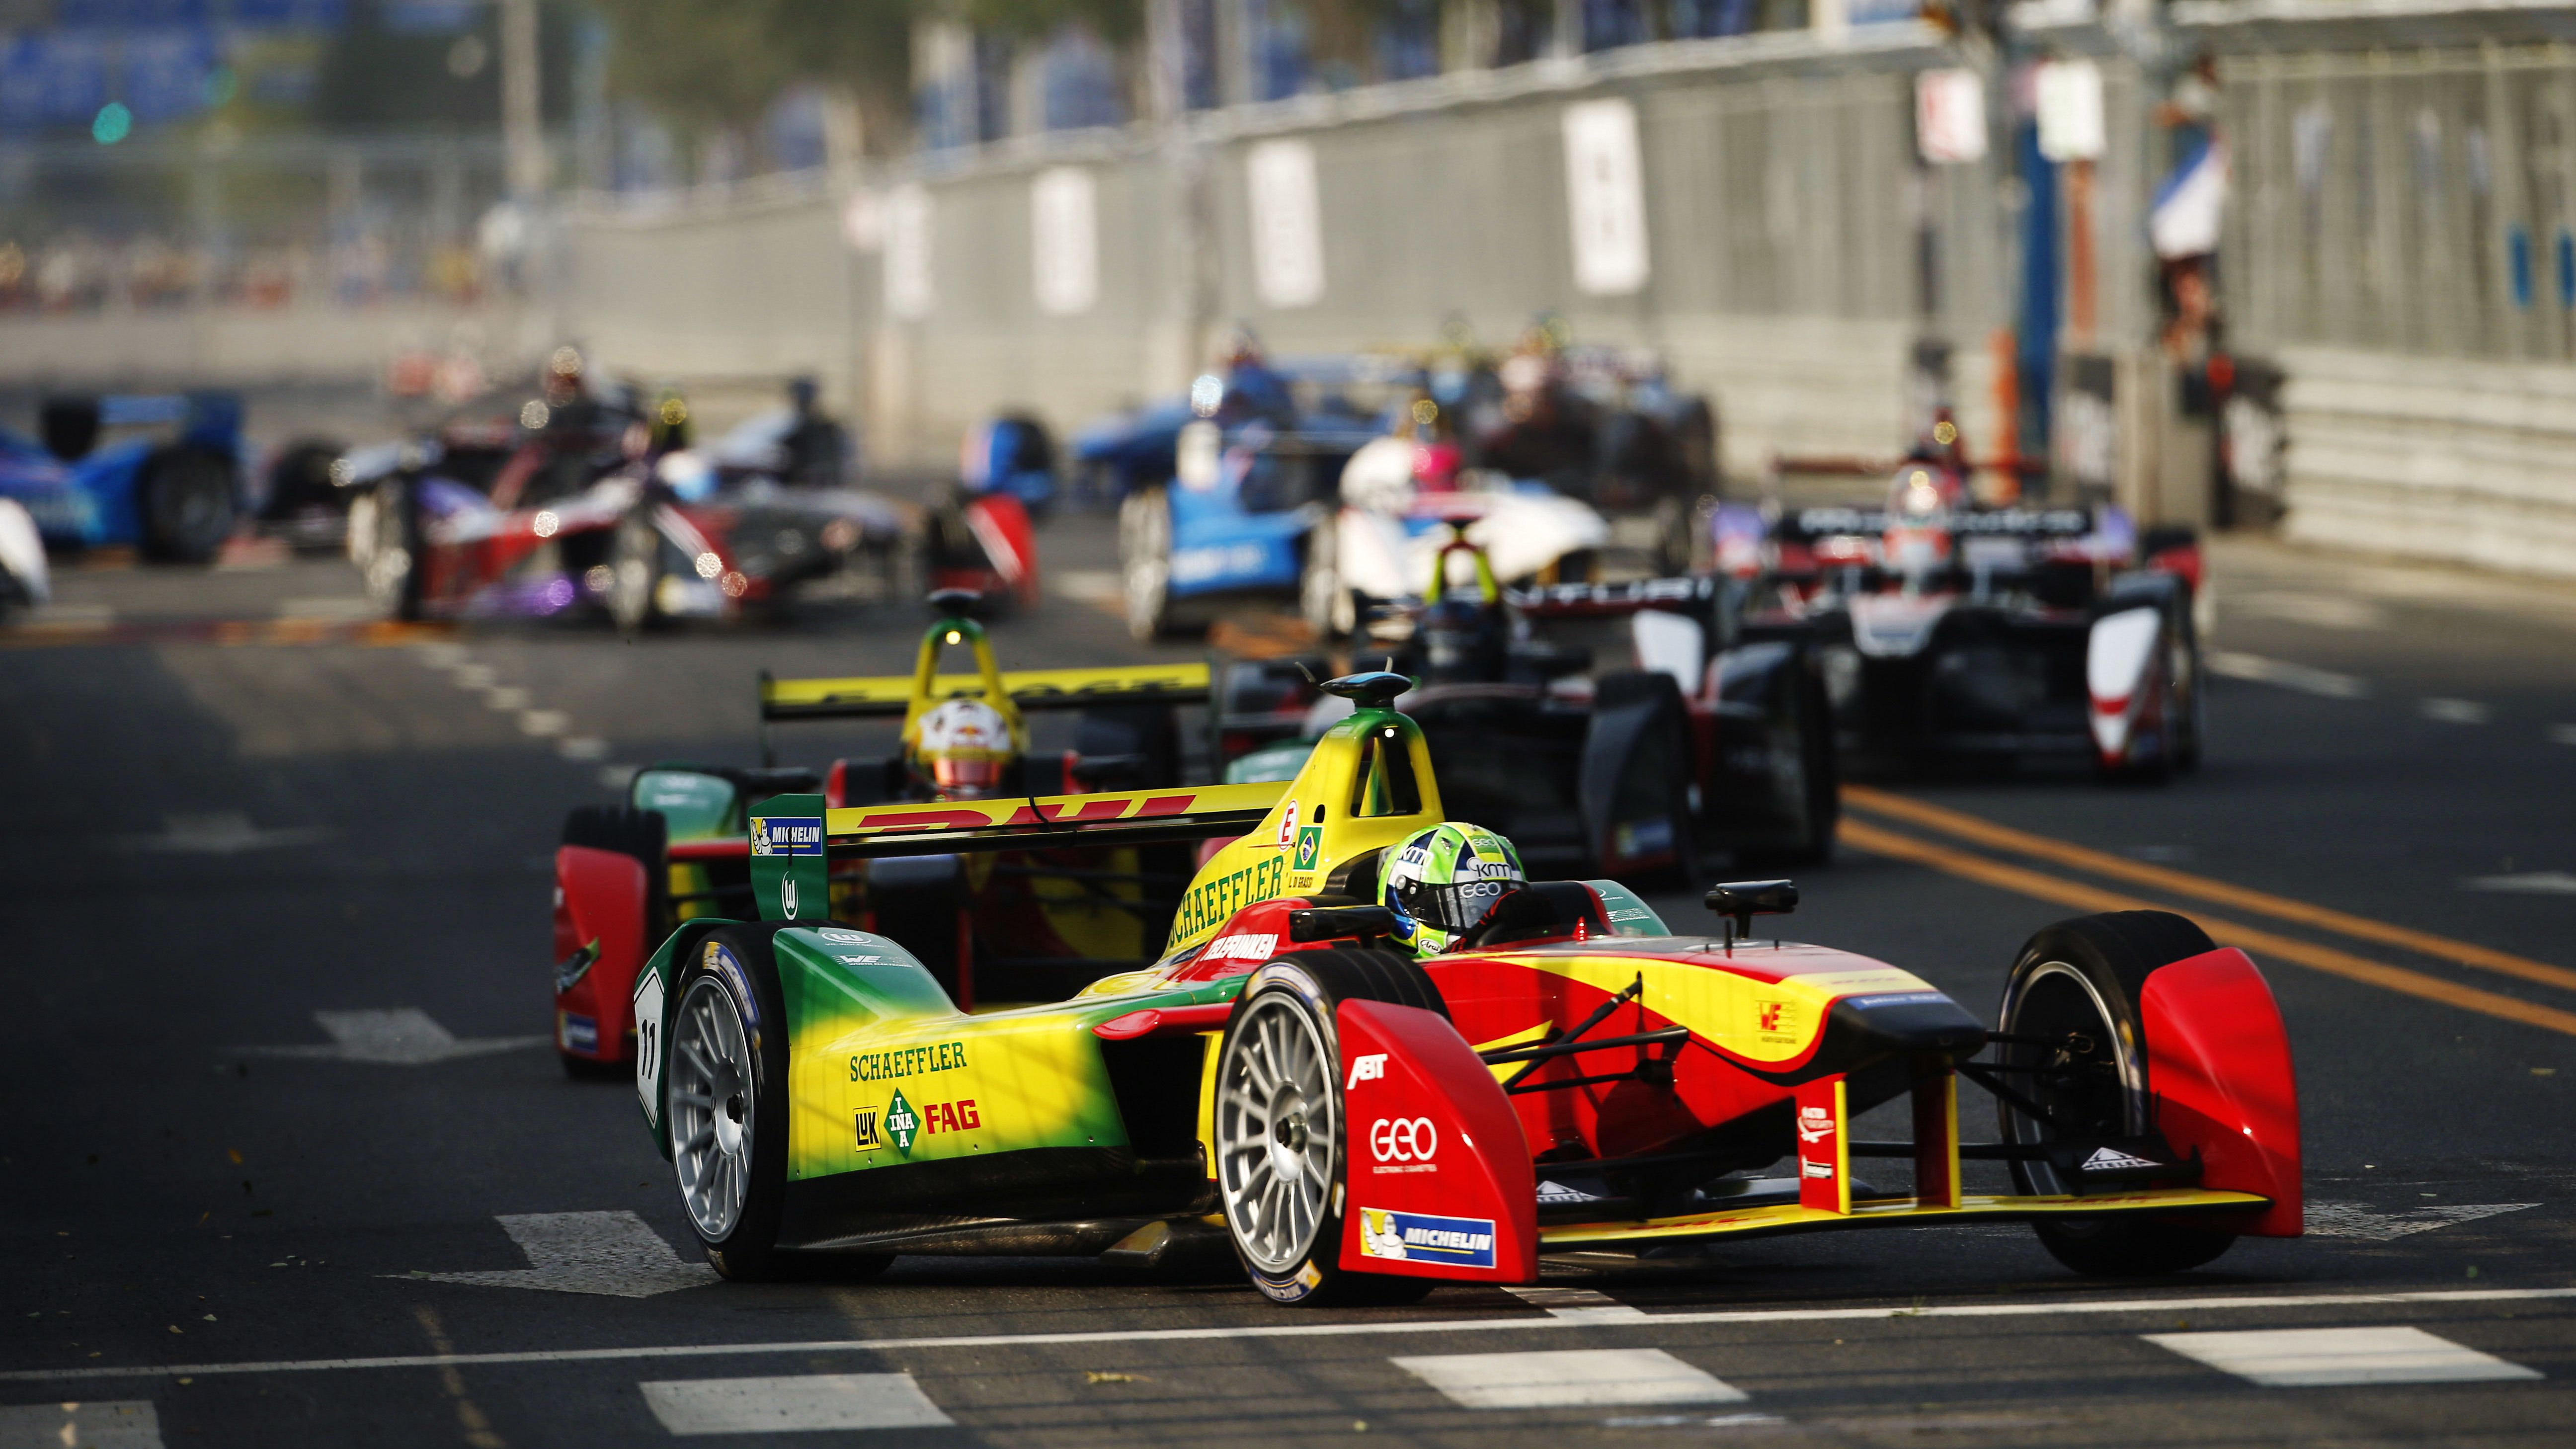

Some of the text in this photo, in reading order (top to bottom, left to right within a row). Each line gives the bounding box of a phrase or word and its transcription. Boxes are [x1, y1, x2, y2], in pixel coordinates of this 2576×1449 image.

[1460, 882, 1501, 898] GEO
[1200, 934, 1279, 962] TELEFUNKEN
[642, 1018, 655, 1080] 11
[850, 1042, 966, 1082] SCHAEFFLER
[1347, 1053, 1388, 1090] ABT
[924, 1099, 981, 1134] FAG
[1370, 1117, 1438, 1162] GEO
[1404, 1227, 1491, 1251] MICHELIN
